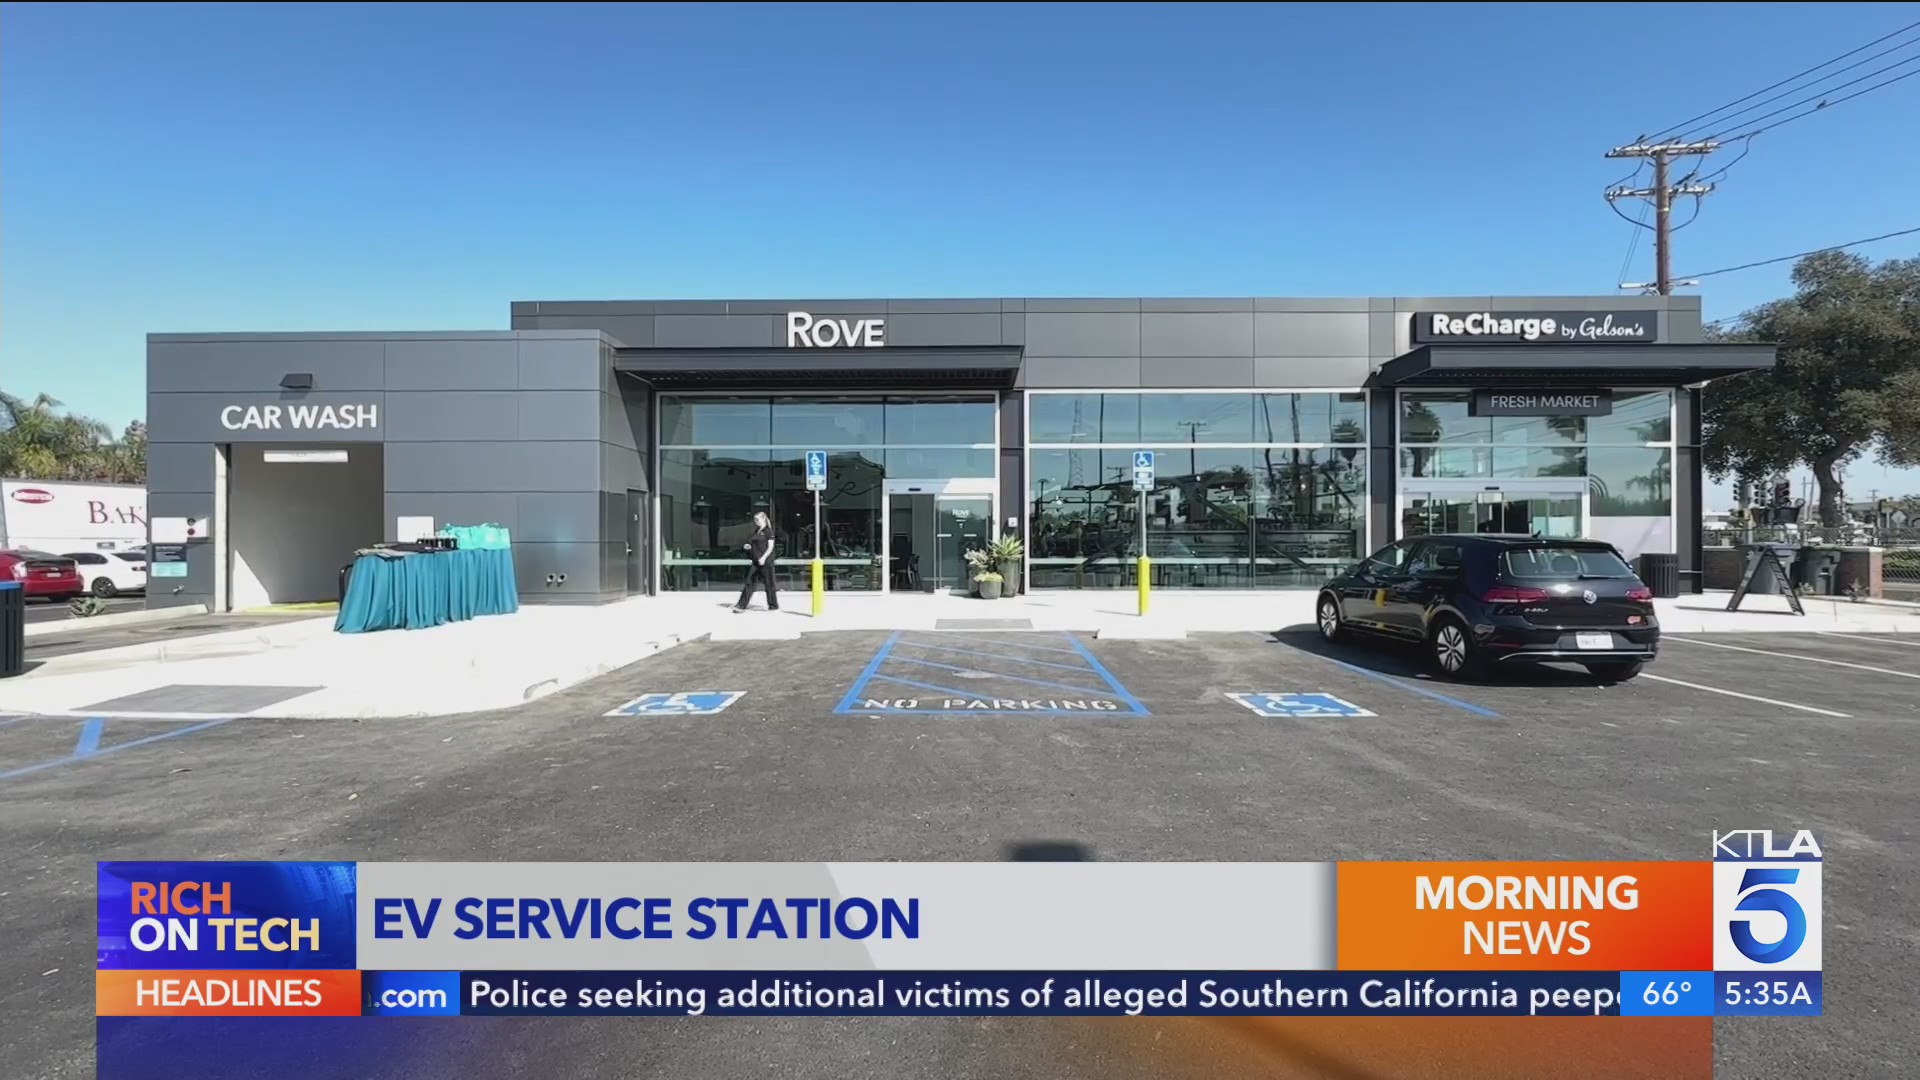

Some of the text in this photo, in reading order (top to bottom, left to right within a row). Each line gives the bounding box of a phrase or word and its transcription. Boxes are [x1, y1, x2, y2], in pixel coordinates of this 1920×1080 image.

[787, 311, 885, 347] ROVE
[1432, 312, 1644, 340] ReCharge by Gelson's
[1490, 395, 1600, 408] FRESH MARKET
[220, 404, 377, 430] CAR WASH
[863, 698, 1118, 711] NO PARKING
